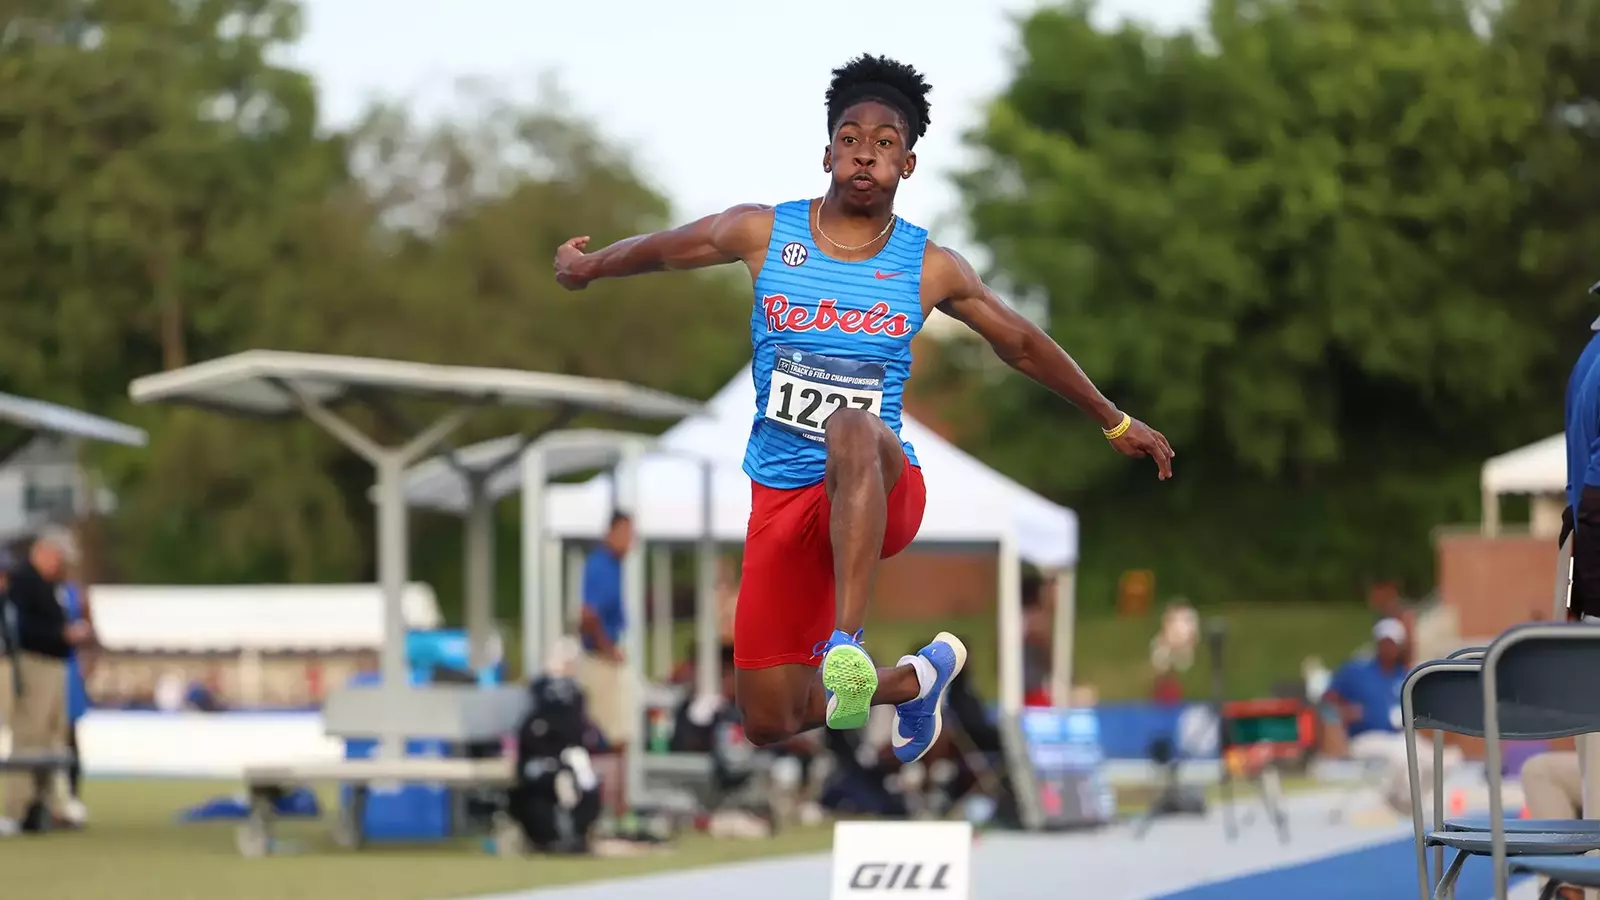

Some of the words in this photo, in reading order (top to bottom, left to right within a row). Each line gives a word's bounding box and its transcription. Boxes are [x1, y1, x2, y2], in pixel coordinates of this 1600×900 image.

[784, 243, 806, 266] SEC
[763, 294, 912, 337] Rebels
[790, 364, 809, 376] TRACK
[813, 370, 831, 380] FIELD
[830, 373, 880, 386] CHAMPIONSHIPS
[849, 863, 951, 890] GILL
